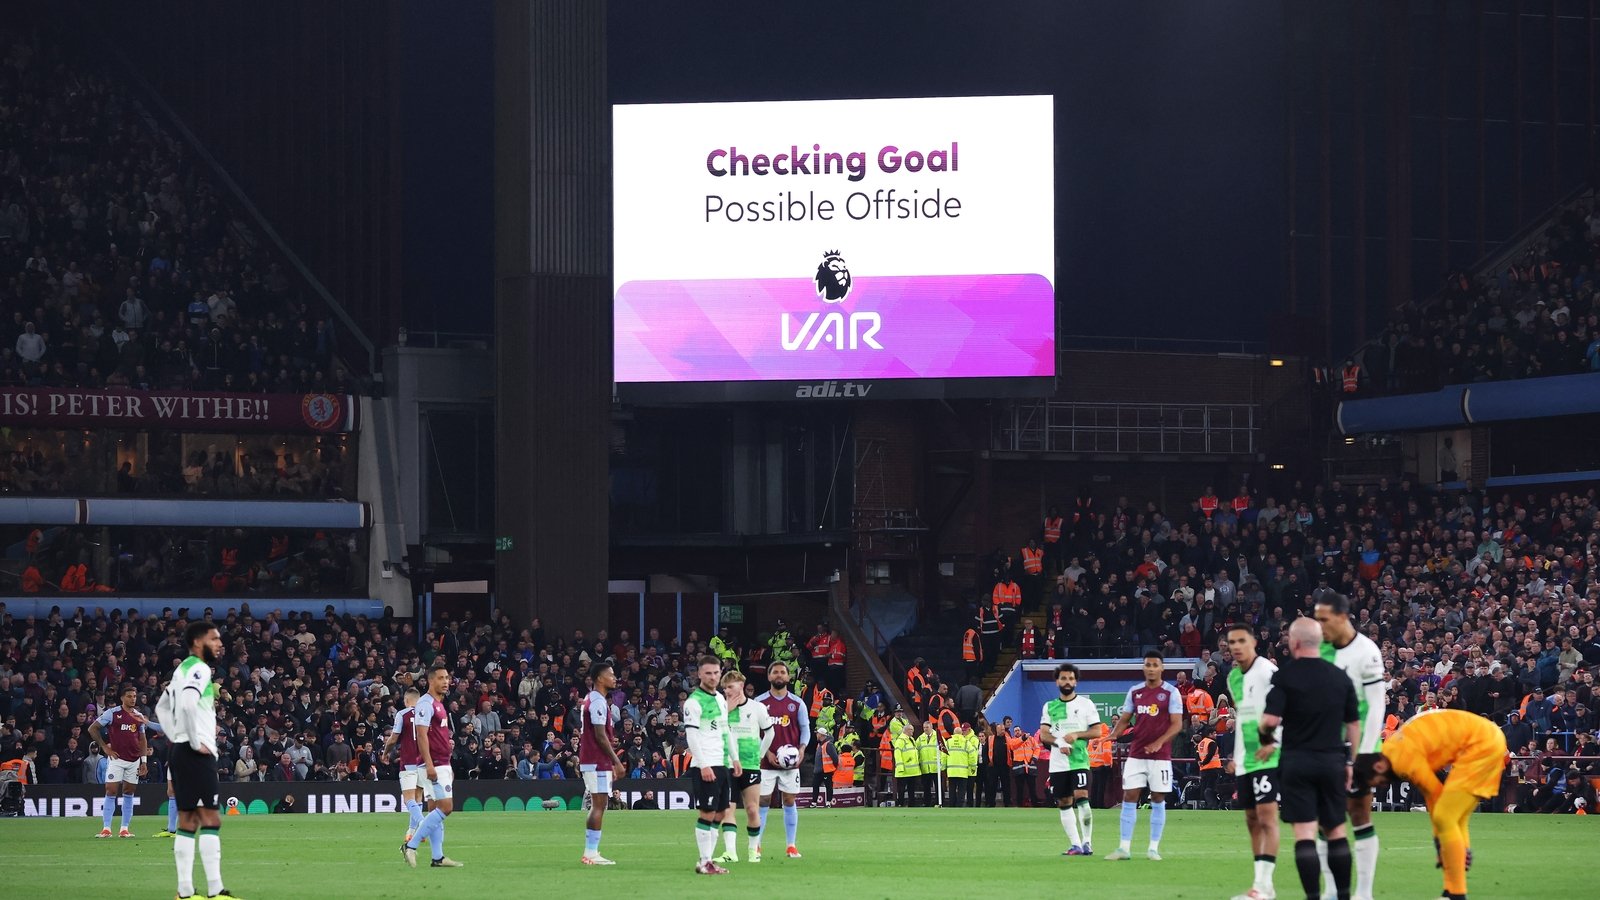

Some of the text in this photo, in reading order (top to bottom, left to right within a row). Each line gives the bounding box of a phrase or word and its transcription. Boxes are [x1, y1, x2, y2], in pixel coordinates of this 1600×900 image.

[706, 141, 958, 182] Checking Goal
[705, 188, 962, 222] Possible Offside
[781, 311, 884, 350] VAR
[795, 381, 872, 398] adi.tv
[2, 393, 269, 421] IS! PETER WITHE!!
[1077, 772, 1087, 787] 11
